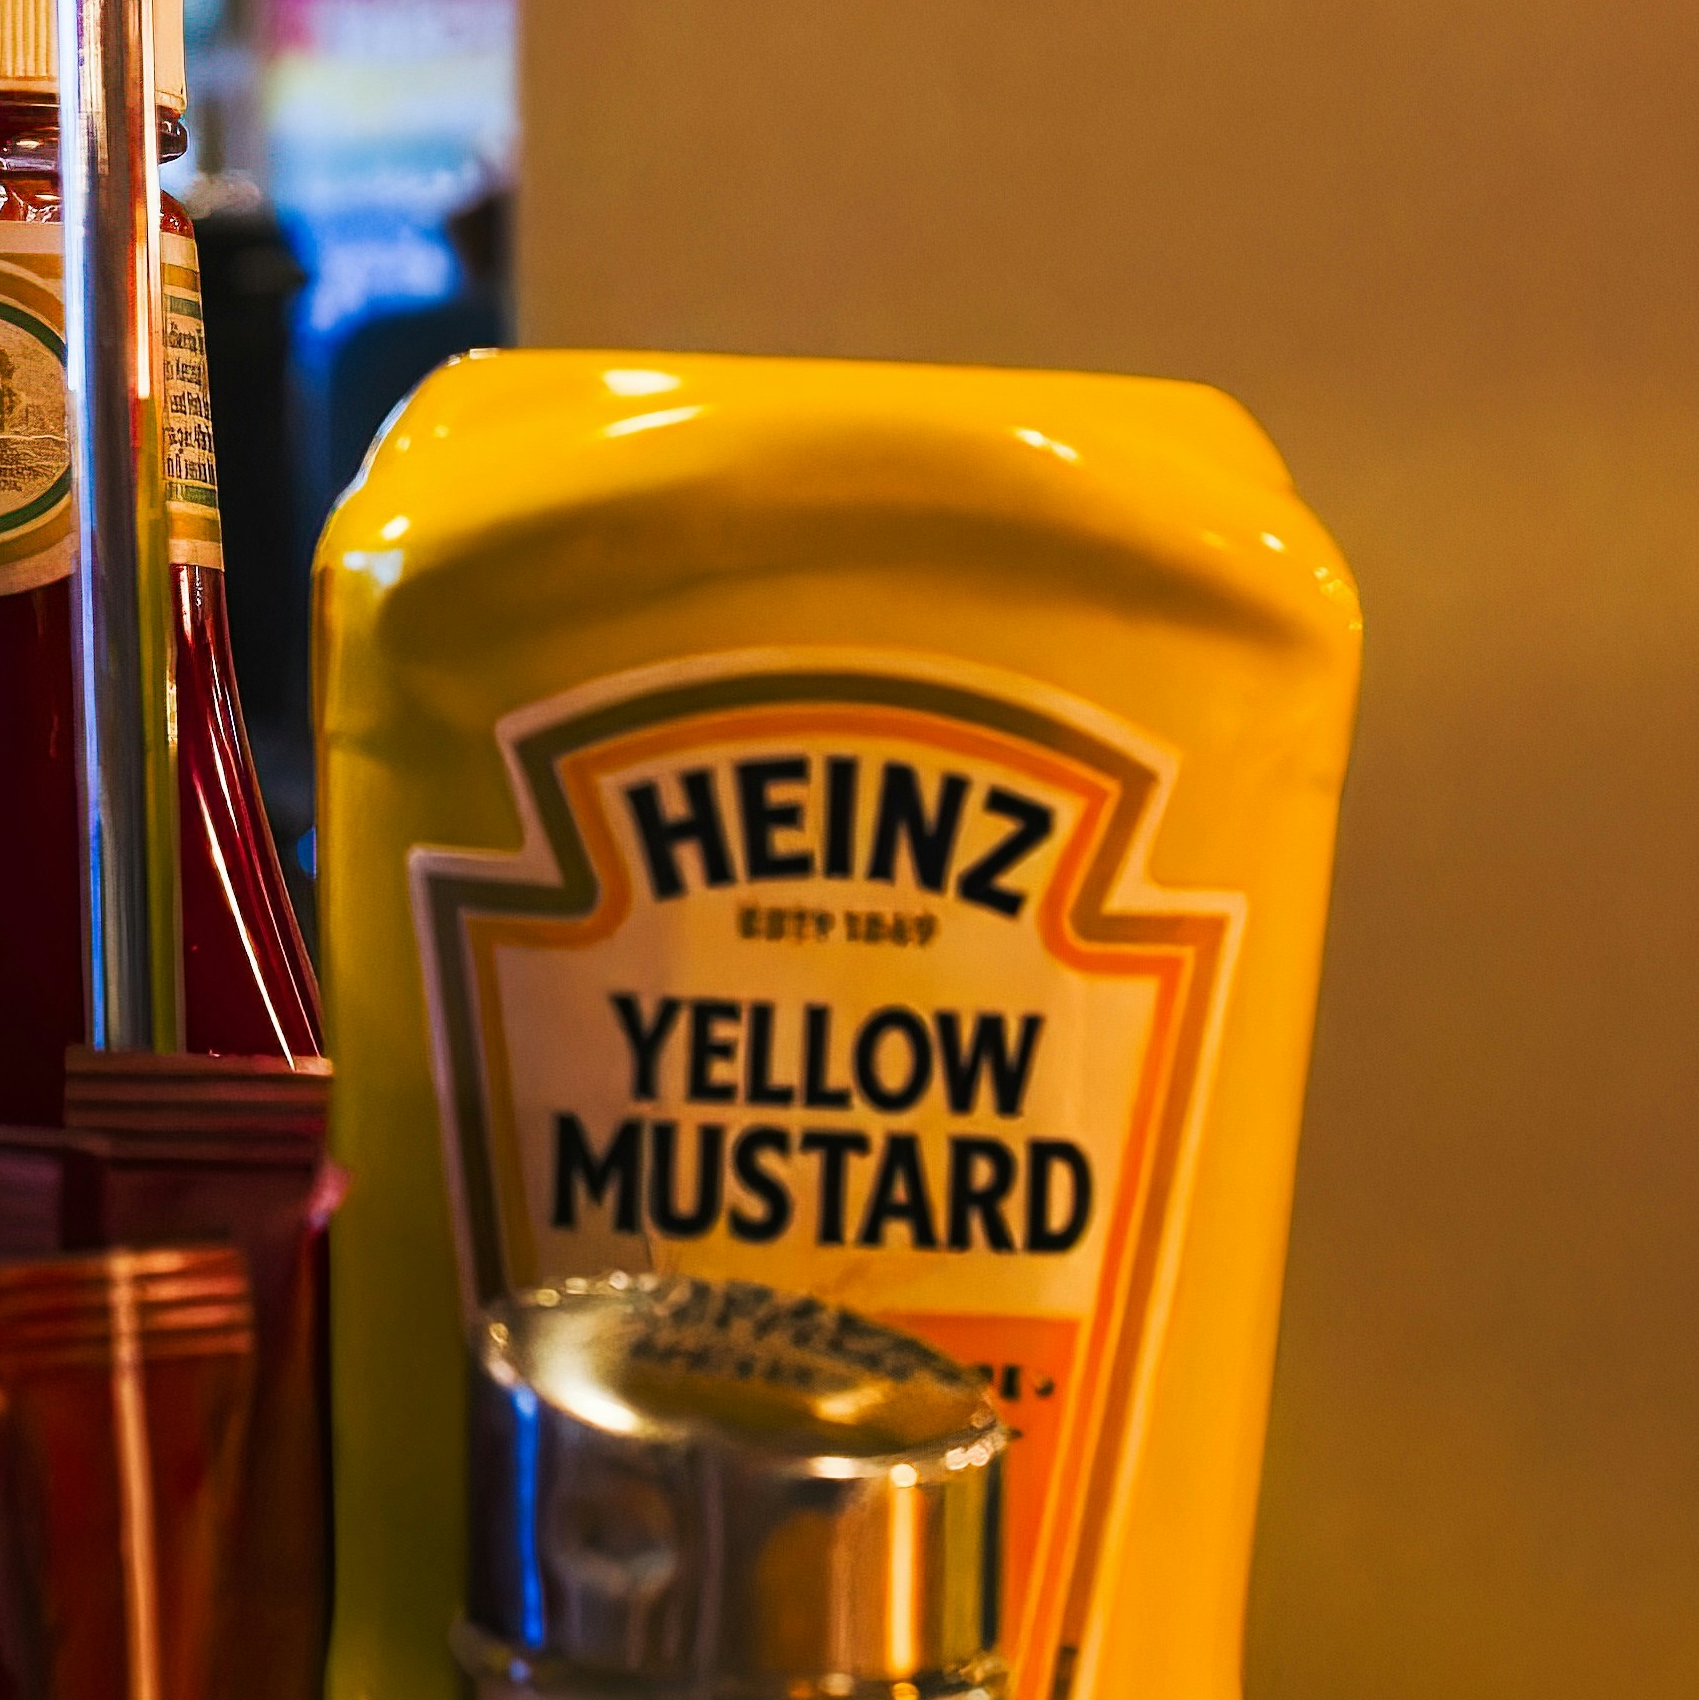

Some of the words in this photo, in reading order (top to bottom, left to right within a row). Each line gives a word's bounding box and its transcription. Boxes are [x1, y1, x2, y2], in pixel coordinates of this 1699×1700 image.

[624, 753, 1056, 919] HEINZ
[611, 992, 1046, 1119] YELLOW
[550, 1111, 1095, 1256] MUSTARD
